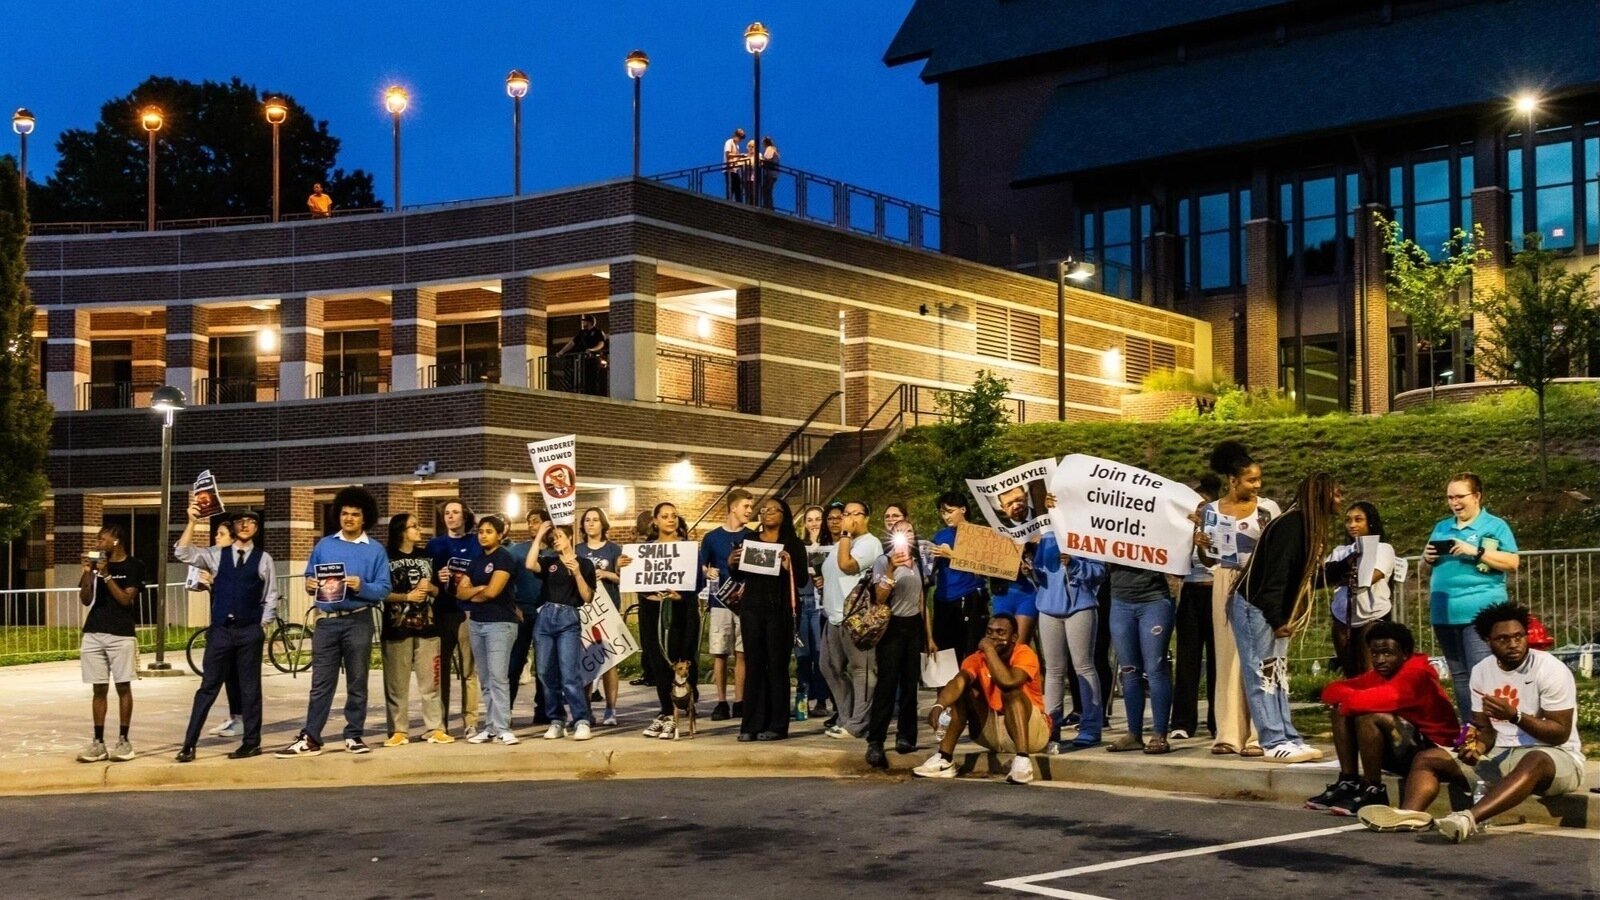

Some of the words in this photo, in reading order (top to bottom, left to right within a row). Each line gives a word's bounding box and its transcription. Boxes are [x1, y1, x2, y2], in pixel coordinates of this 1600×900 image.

[538, 451, 573, 464] ALLOWED
[976, 483, 999, 494] FUCK
[999, 475, 1021, 489] YOU
[1020, 466, 1048, 479] KYLE!
[1089, 464, 1127, 482] Join
[1132, 473, 1163, 489] the
[550, 502, 562, 511] SAY
[562, 500, 573, 508] NO
[1087, 487, 1156, 513] civilized
[1090, 515, 1147, 537] world:
[638, 544, 681, 559] SMALL
[1067, 532, 1108, 555] BAN
[1112, 541, 1168, 566] GUNS
[389, 559, 405, 572] ORN
[635, 571, 686, 585] ENERGY
[578, 596, 609, 625] OPLE
[578, 618, 610, 652] NOT
[582, 633, 633, 672] GUNS!
